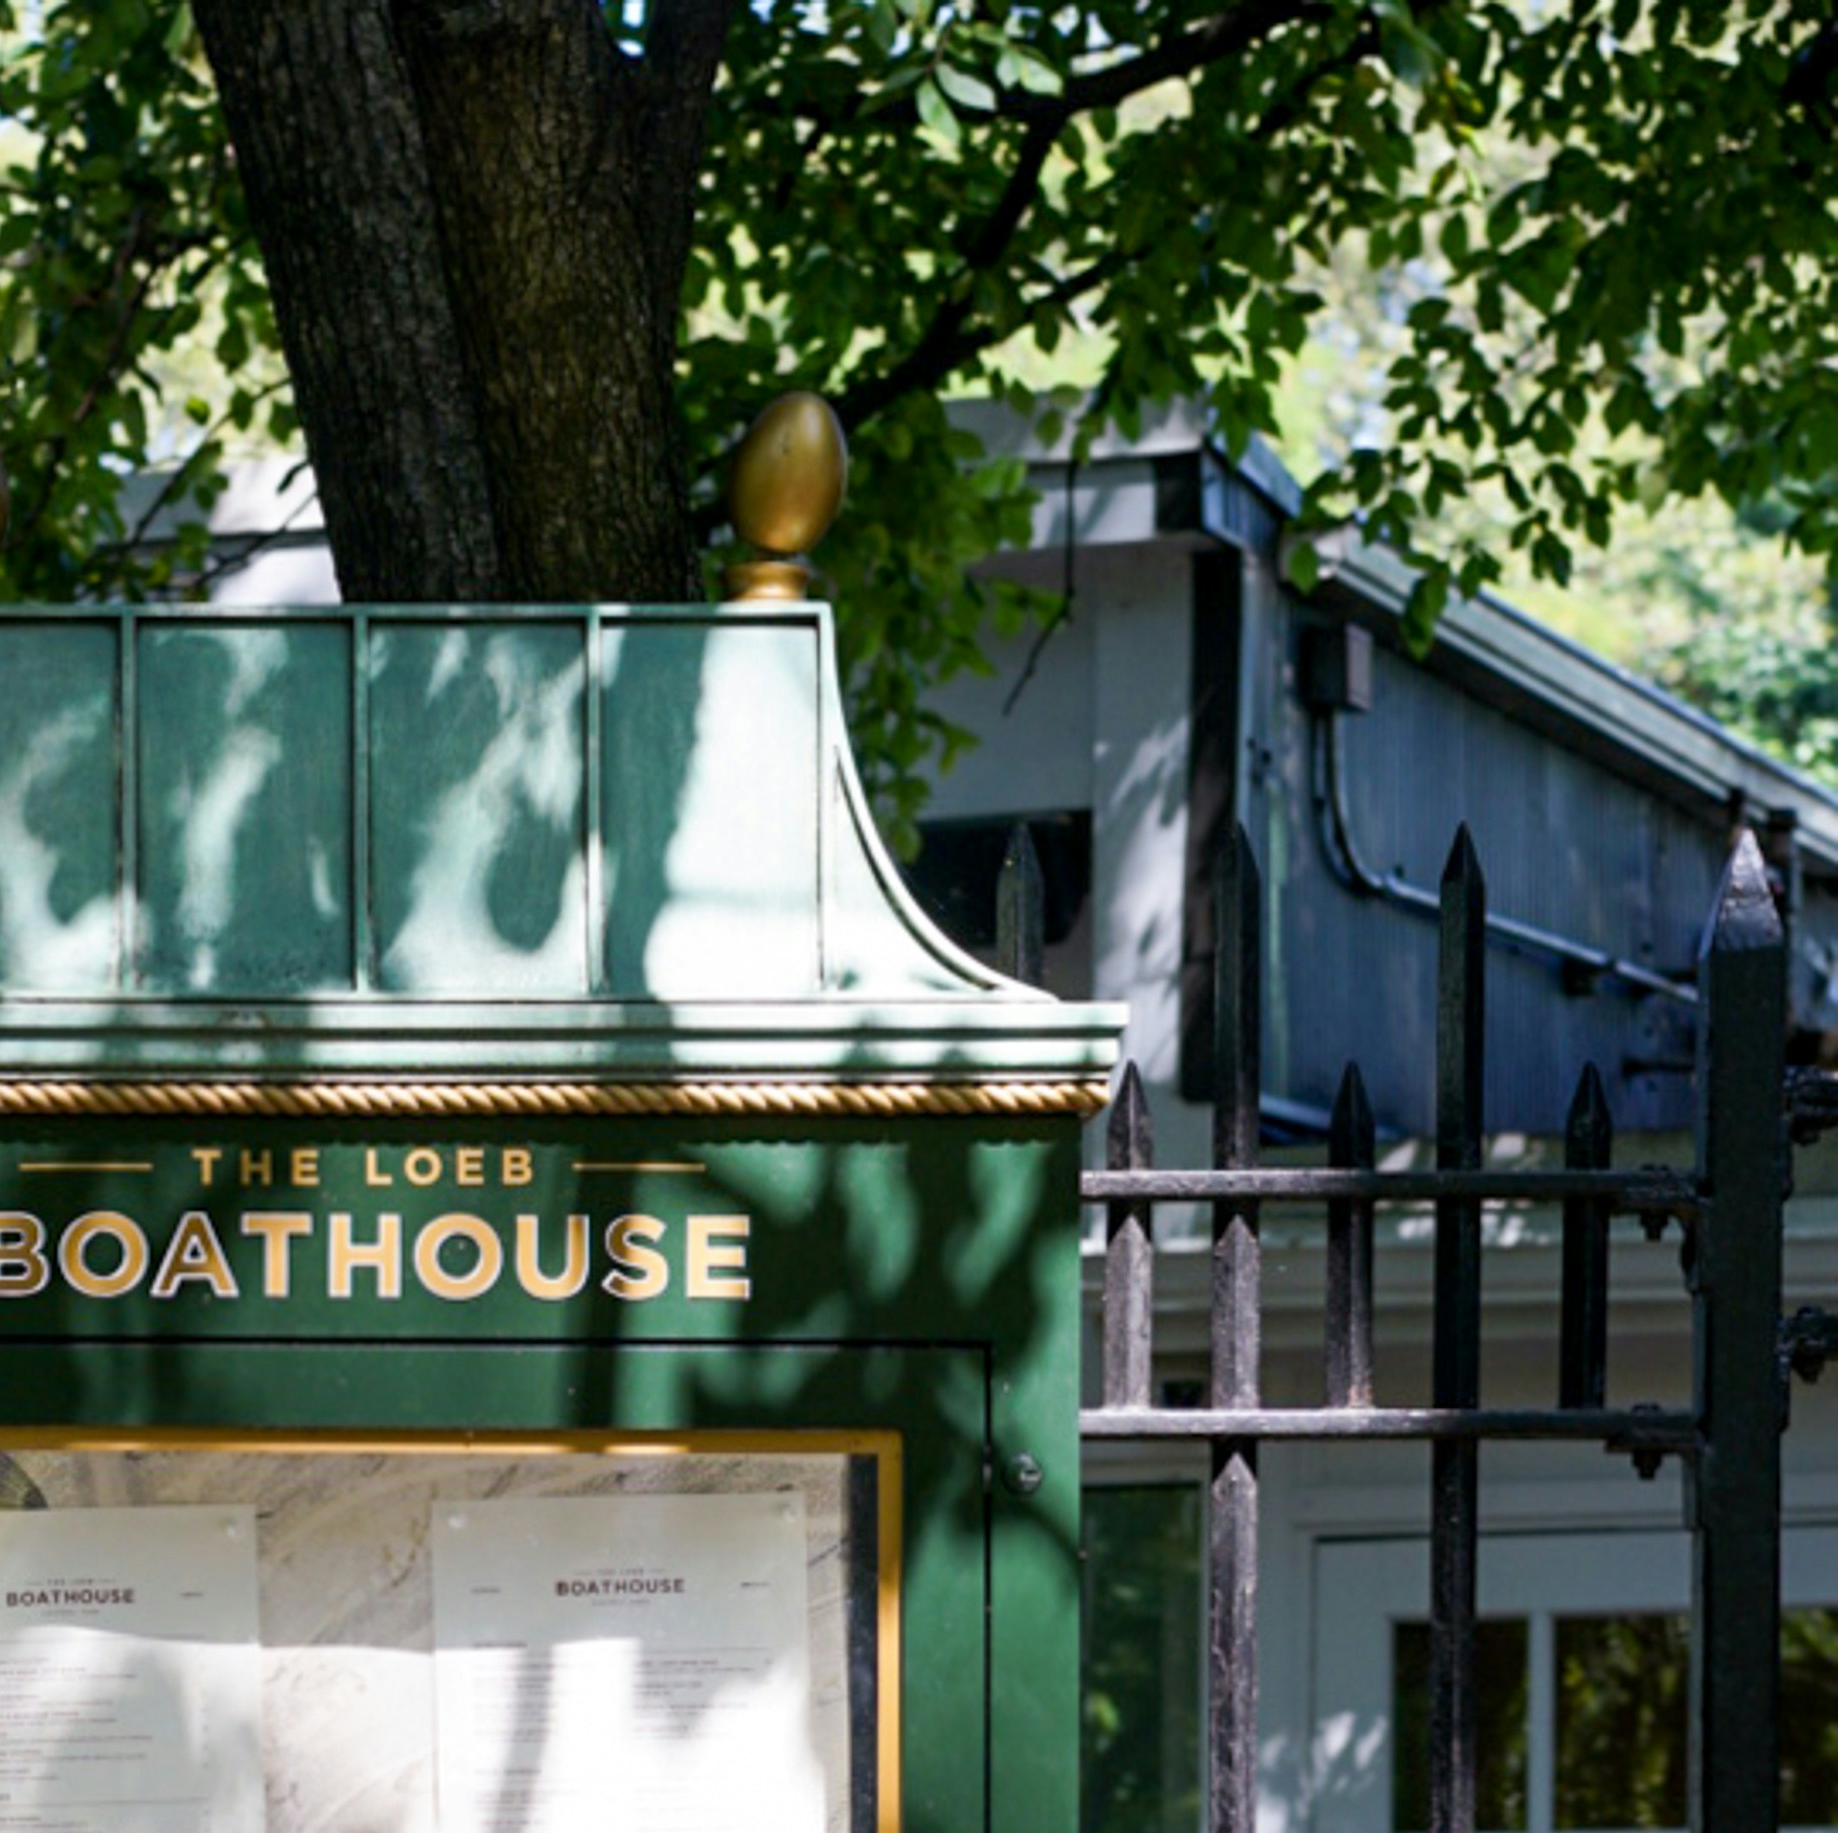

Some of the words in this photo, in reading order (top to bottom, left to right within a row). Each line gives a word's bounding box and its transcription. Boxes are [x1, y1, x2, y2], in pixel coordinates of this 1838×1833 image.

[191, 1147, 321, 1186] THE
[366, 1147, 535, 1187] LOEB
[5, 1588, 136, 1608] BOATHOUSE
[554, 1577, 686, 1598] BOATHOUSE
